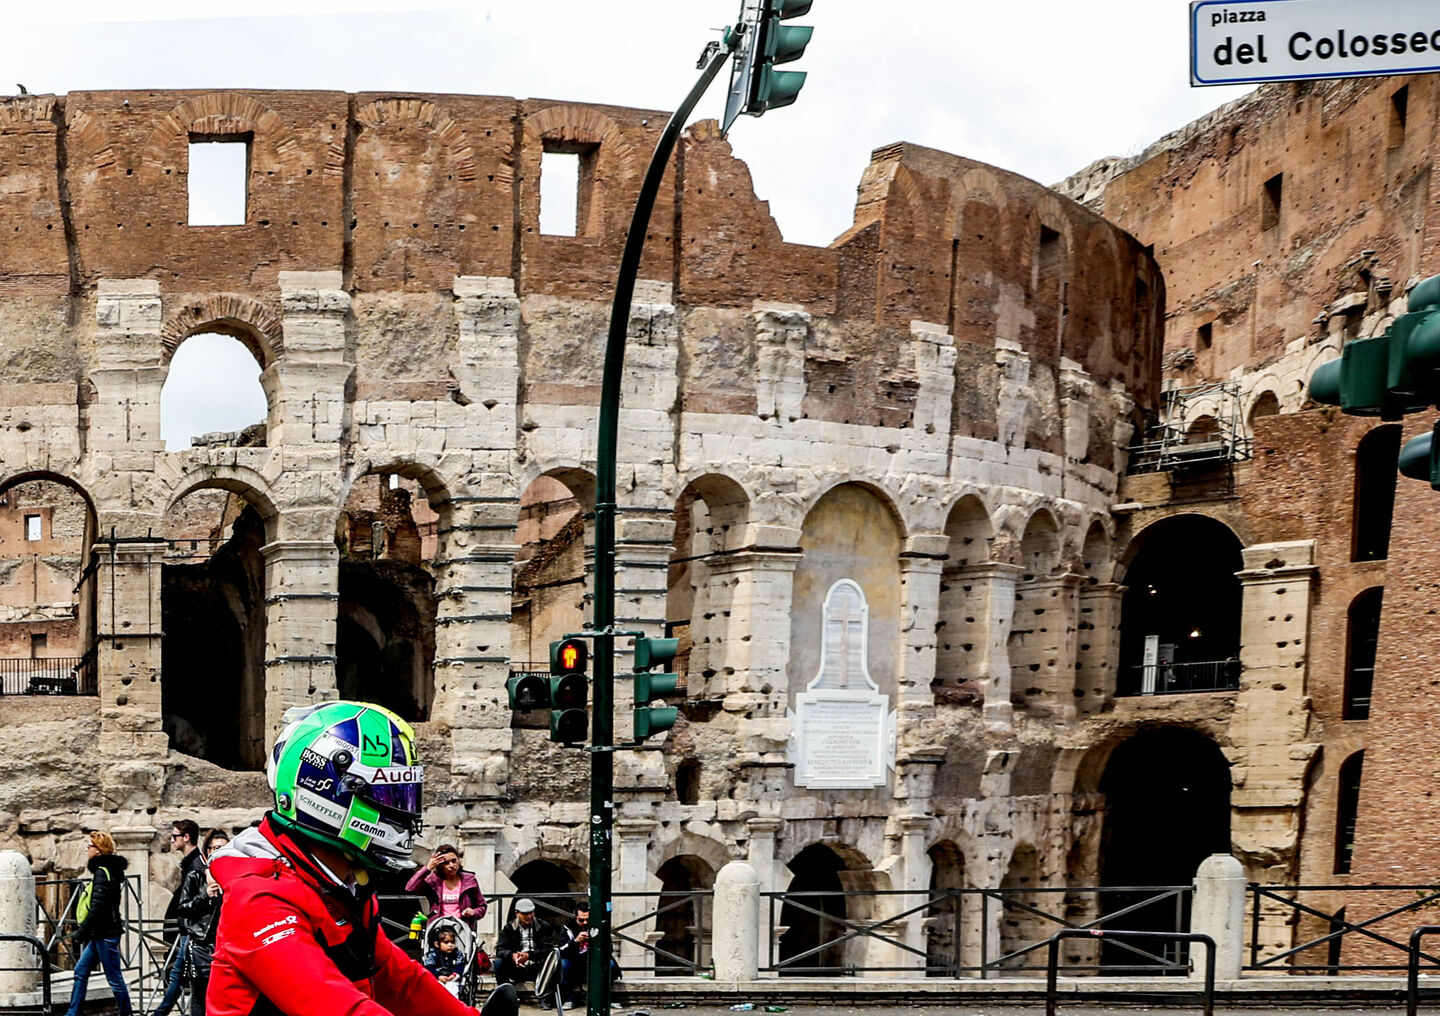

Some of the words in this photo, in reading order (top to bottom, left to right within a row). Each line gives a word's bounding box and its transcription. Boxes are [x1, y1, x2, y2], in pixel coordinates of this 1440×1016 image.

[1212, 9, 1266, 27] piazza
[1214, 34, 1268, 66] del
[302, 748, 327, 767] BOSS
[371, 767, 417, 783] Audi
[299, 794, 343, 820] SCHAEFFLER
